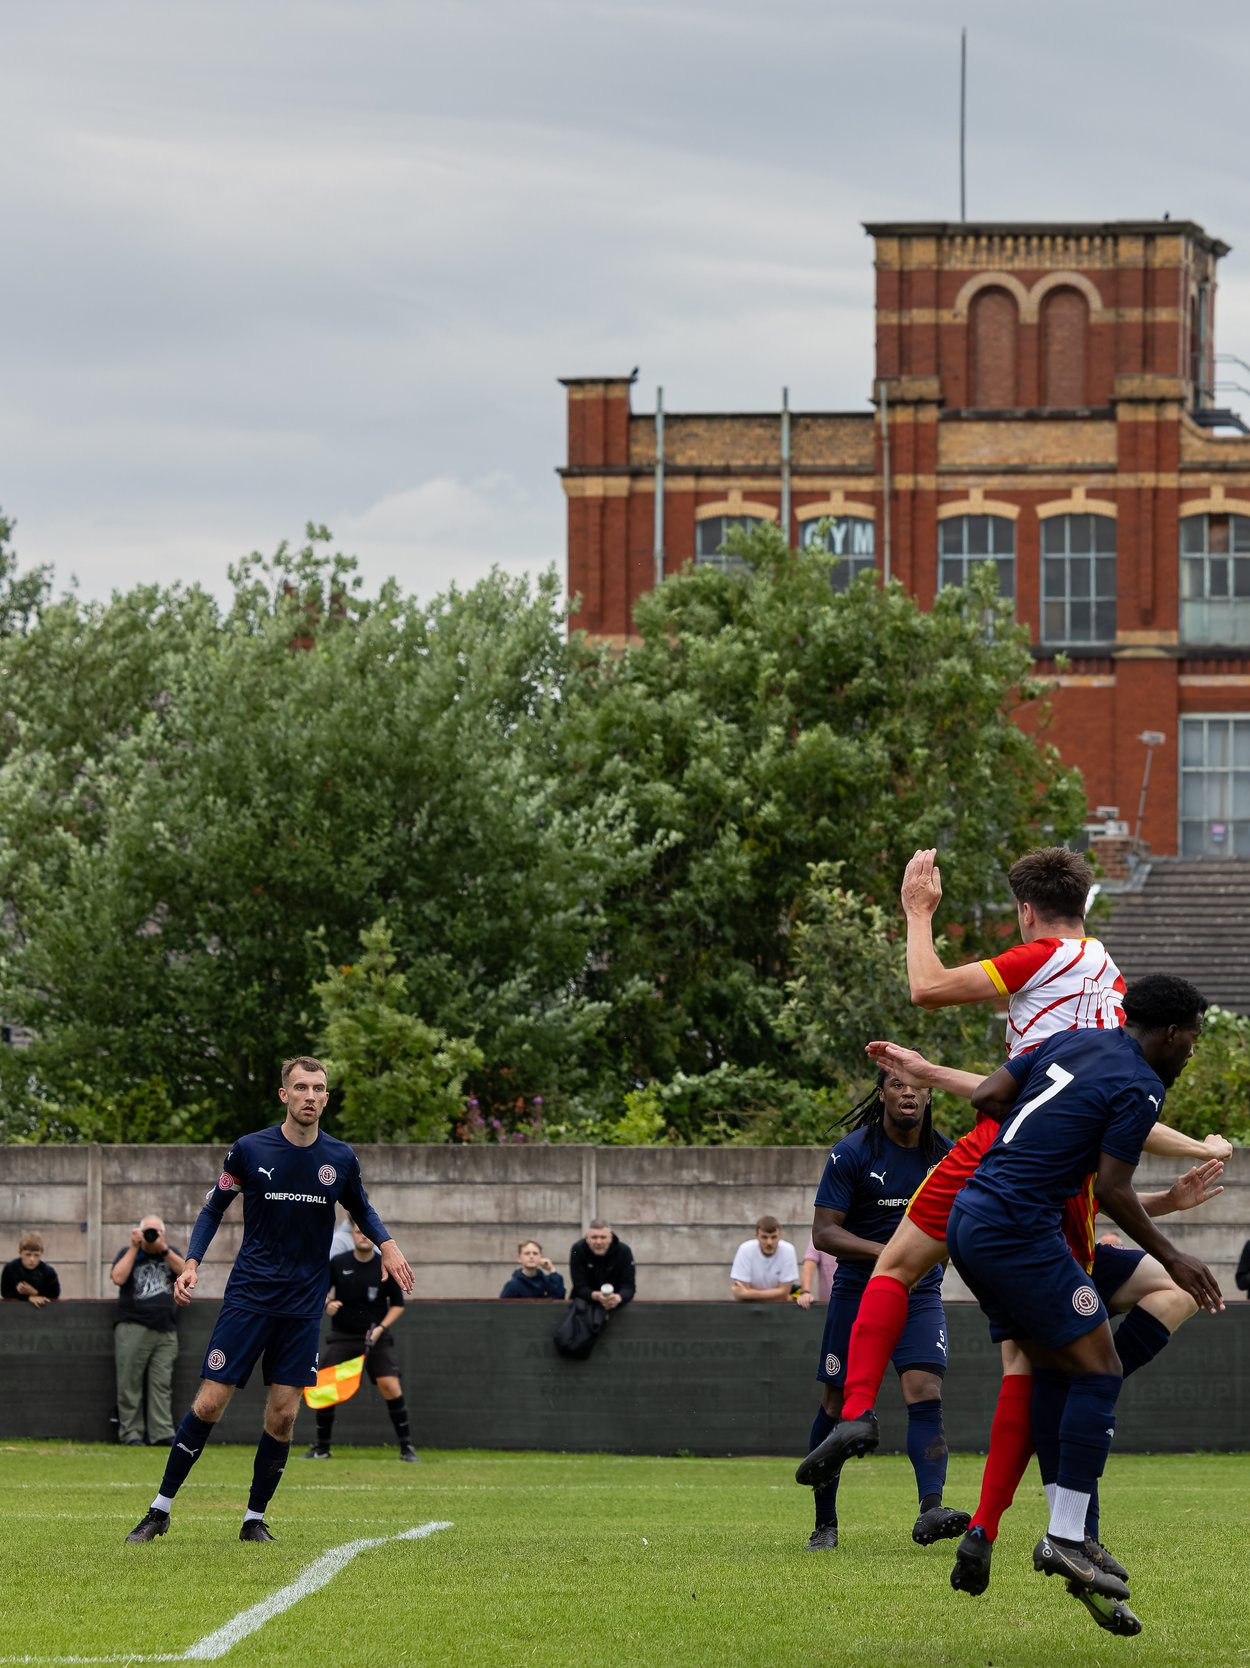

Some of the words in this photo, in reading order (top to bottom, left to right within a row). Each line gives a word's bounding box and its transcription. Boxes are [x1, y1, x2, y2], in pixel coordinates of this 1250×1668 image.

[1003, 1062, 1075, 1144] 7
[264, 1192, 327, 1204] ONEFOOTBALL
[939, 1329, 945, 1342] 5
